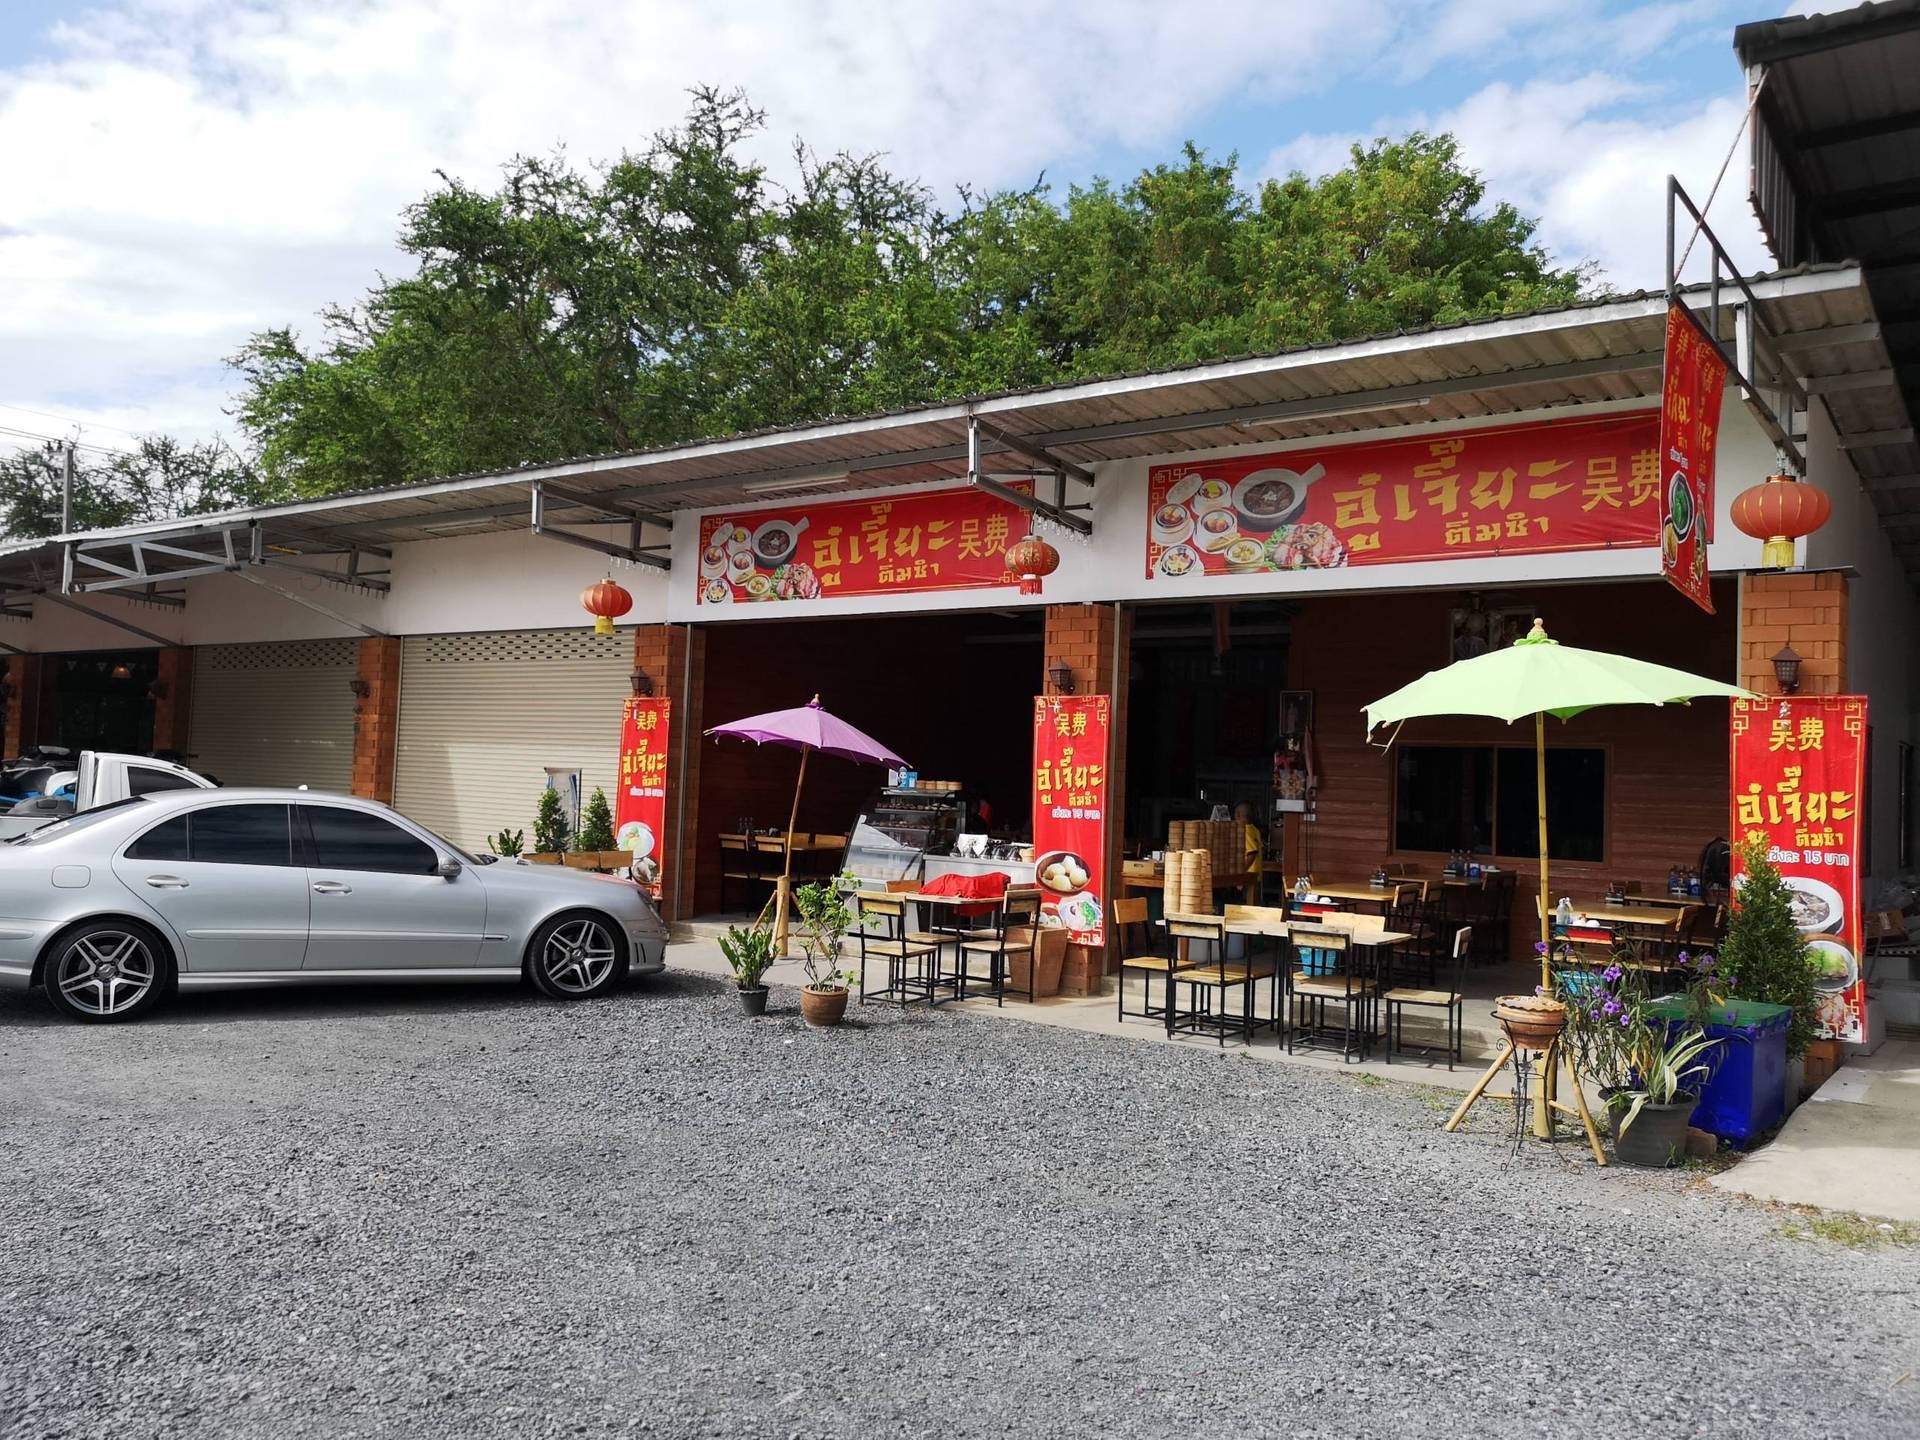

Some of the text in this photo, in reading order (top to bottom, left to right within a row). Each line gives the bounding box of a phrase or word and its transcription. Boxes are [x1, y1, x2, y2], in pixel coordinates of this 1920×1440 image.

[958, 514, 1009, 560] 吴费
[1444, 512, 1550, 546] ติ่มซำ
[878, 557, 941, 585] ติ่มซำ
[1056, 711, 1087, 737] 吴费
[1768, 717, 1824, 752] 吴费
[1795, 822, 1844, 847] ติ่มซำ
[1803, 850, 1822, 865] 15
[1824, 852, 1849, 866] บาท
